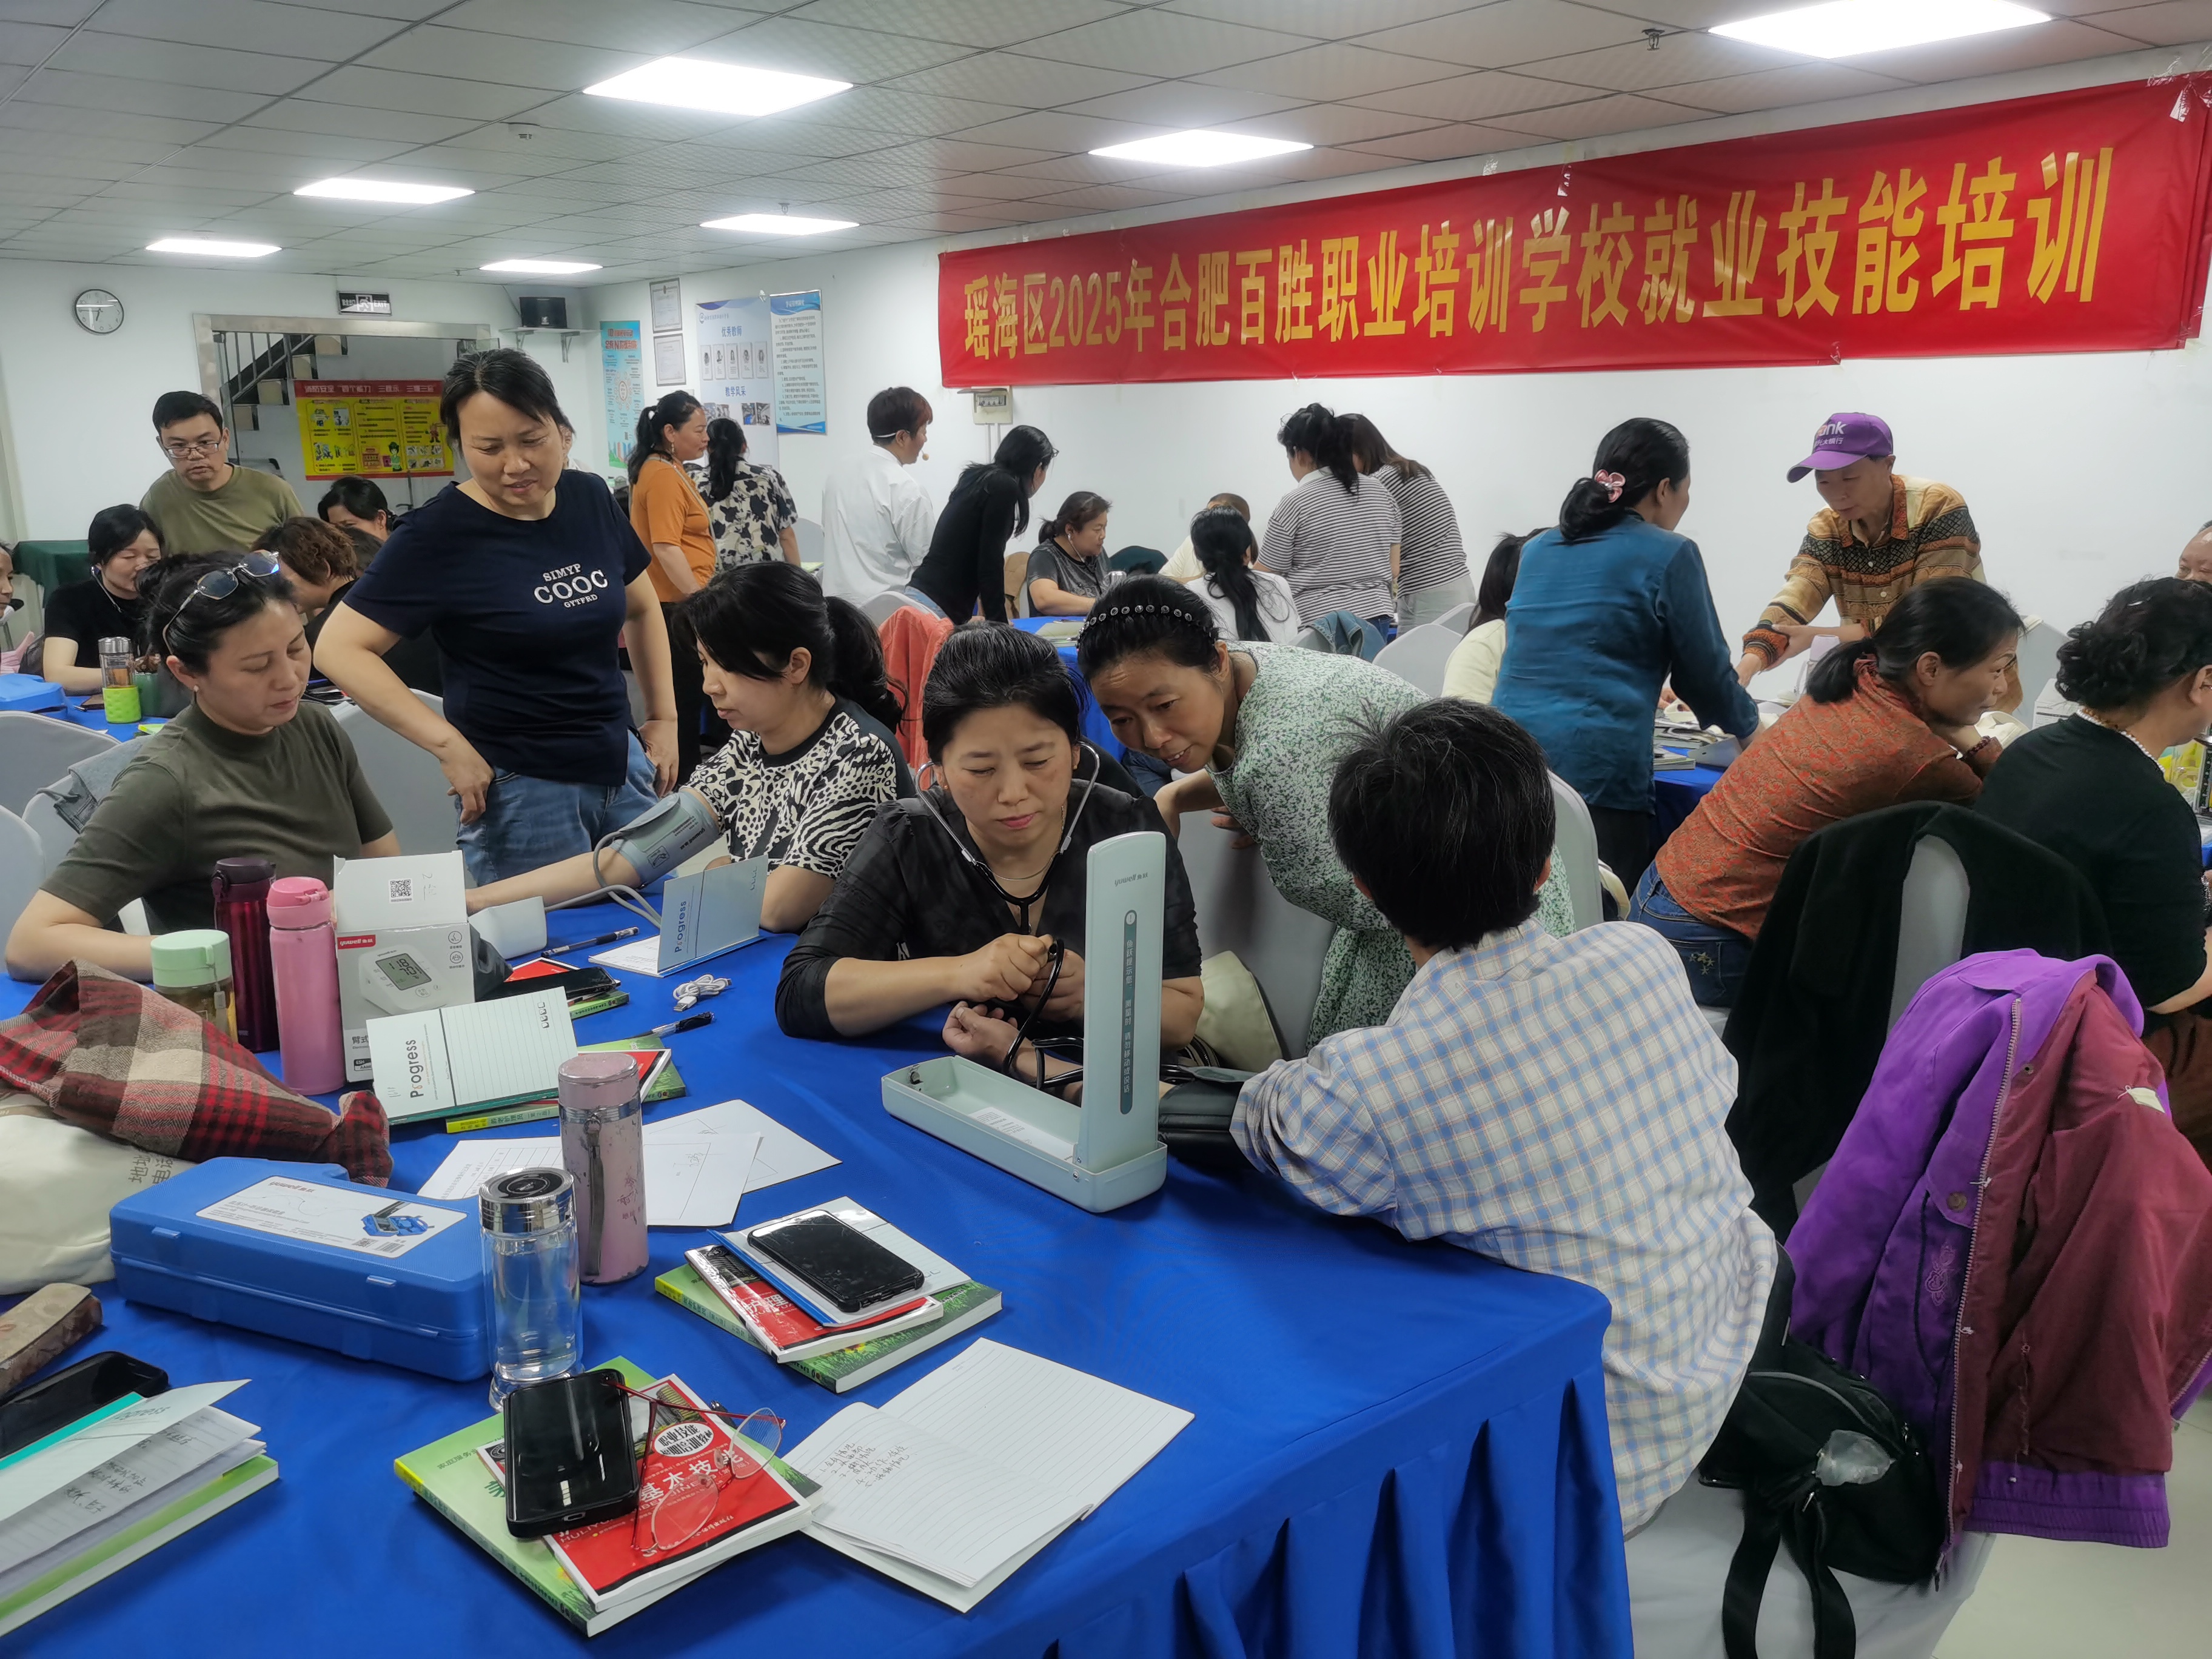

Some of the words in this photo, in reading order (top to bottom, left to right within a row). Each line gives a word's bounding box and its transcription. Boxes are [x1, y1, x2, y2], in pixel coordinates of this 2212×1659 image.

[964, 147, 2114, 360] 瑶海区2025年合肥百胜职业培训学校就业技能培训
[722, 326, 743, 337] 优秀教师
[725, 386, 746, 397] 教学风采
[1818, 421, 1847, 436] ank
[543, 563, 581, 581] SIMYP
[534, 570, 608, 603] COOC
[564, 594, 598, 608] GYTFRD
[1114, 874, 1136, 886] yuwell
[406, 1039, 424, 1098] Progress
[128, 1155, 150, 1184] 地址
[268, 1181, 301, 1190] yuwell
[658, 1424, 700, 1447] 职业技能
[641, 1449, 744, 1503] 基本技能
